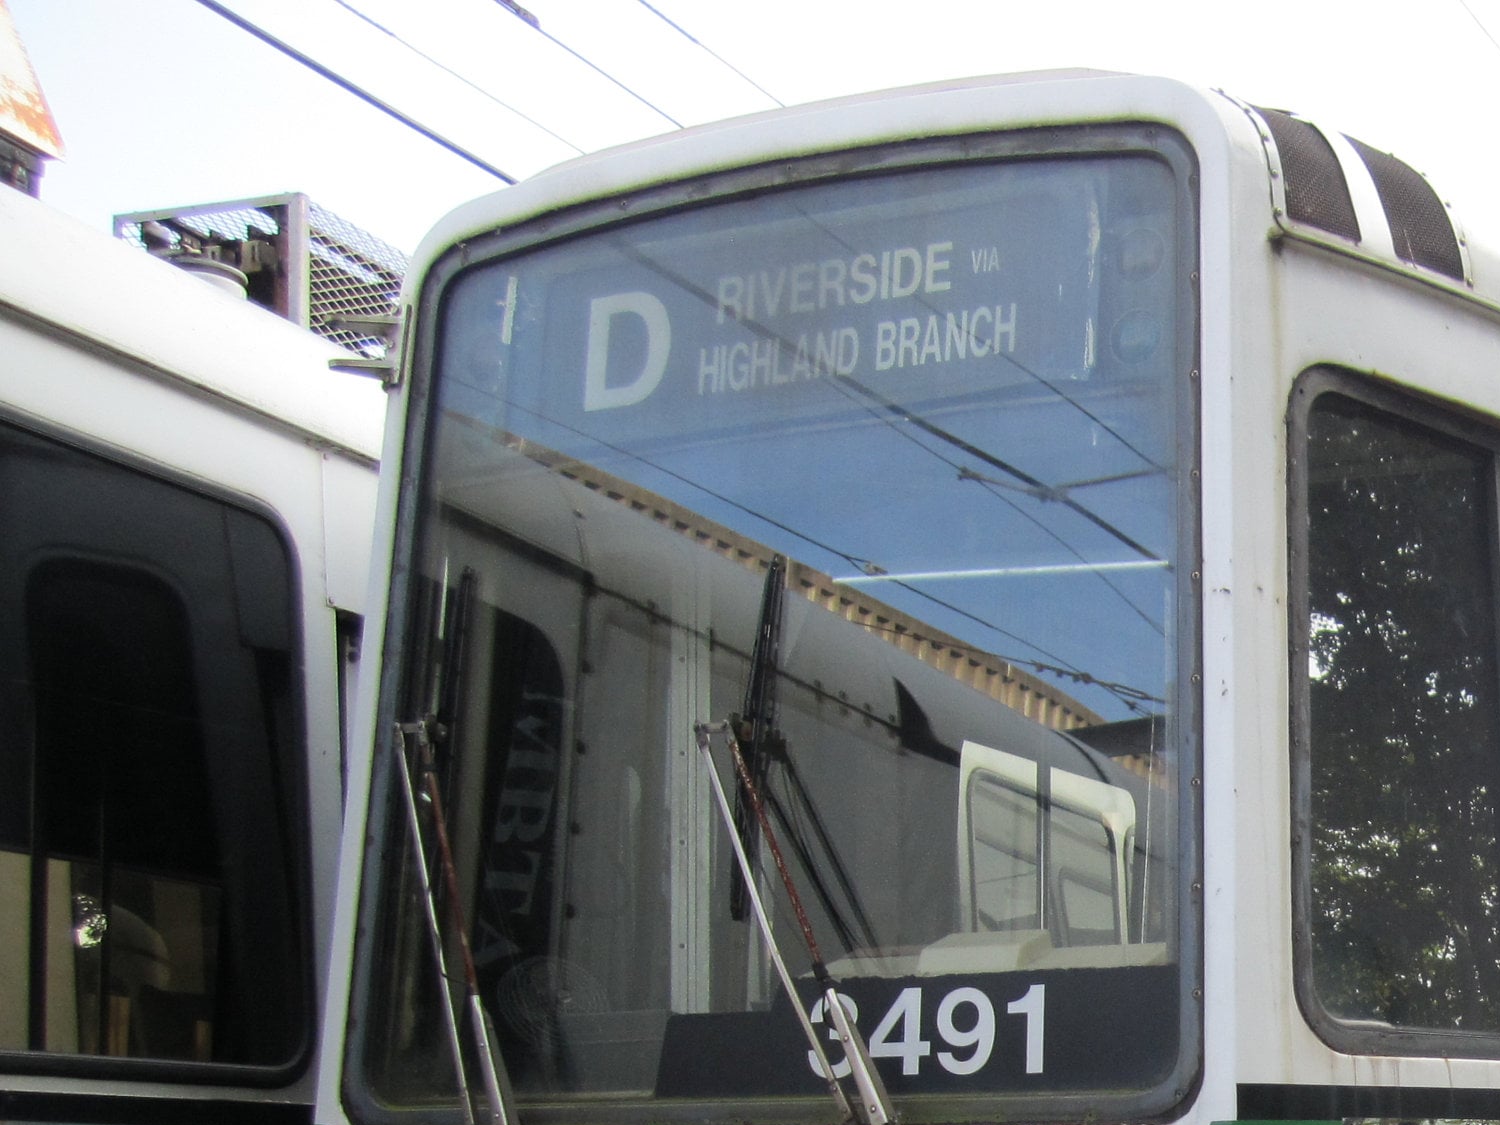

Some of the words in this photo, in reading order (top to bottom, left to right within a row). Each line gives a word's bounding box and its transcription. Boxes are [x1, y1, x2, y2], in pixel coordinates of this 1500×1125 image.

[716, 241, 954, 325] RIVERSIDE
[971, 247, 1000, 273] VIA
[584, 290, 672, 411] D
[698, 327, 860, 396] HIGHLAND
[875, 303, 1017, 371] BRANCH
[808, 984, 1045, 1078] 3491
